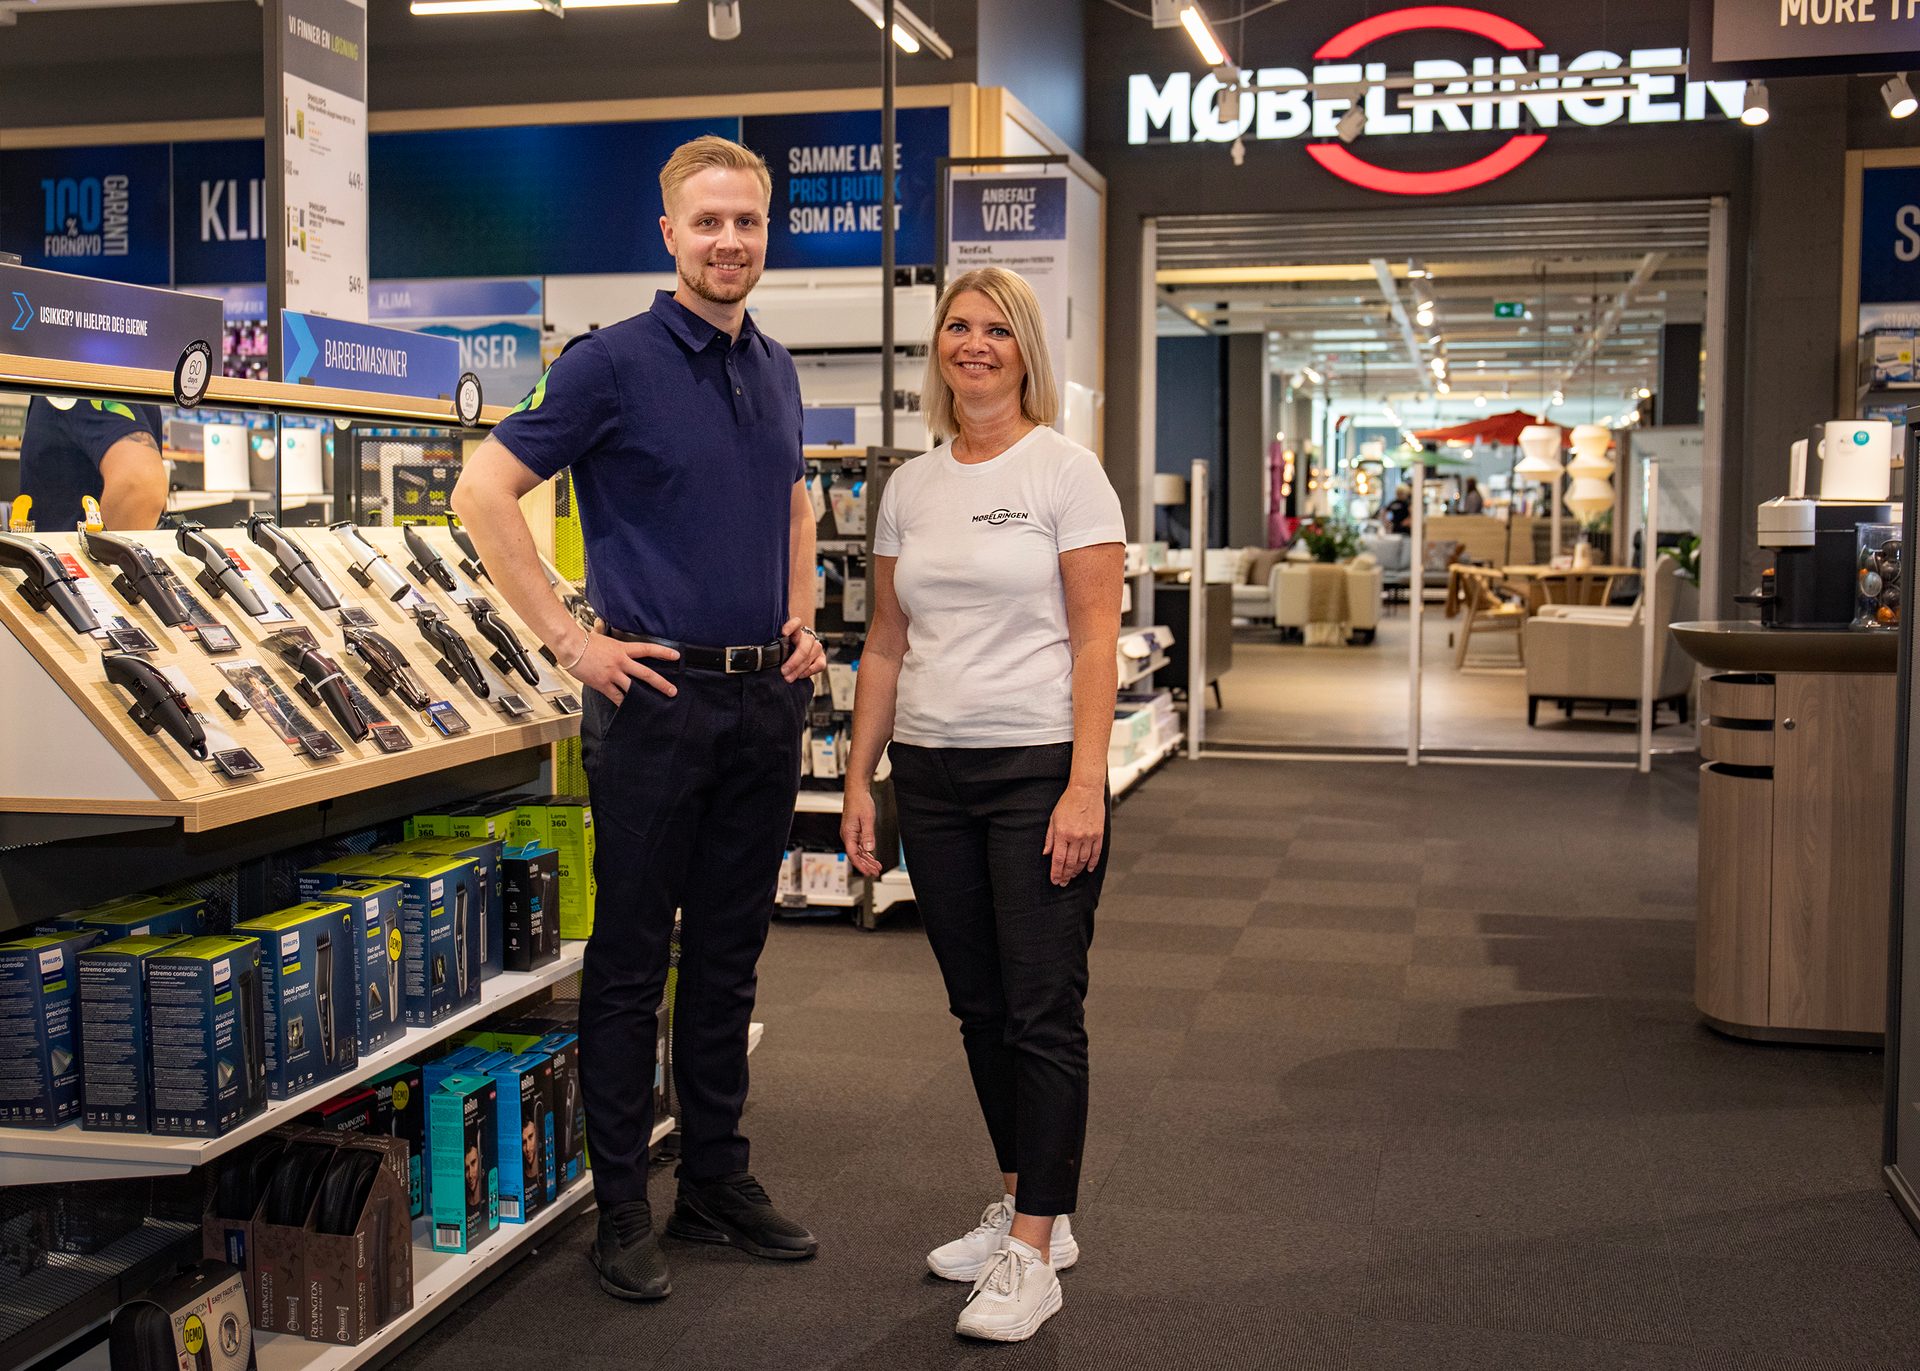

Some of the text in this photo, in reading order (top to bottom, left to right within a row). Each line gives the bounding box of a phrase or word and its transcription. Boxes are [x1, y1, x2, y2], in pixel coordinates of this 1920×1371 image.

[1780, 0, 1876, 26] MORE
[288, 14, 359, 61] VI FINNER EN LØSNING
[1128, 47, 1747, 145] MØBELRINGEN
[788, 145, 856, 174] SAMME
[789, 176, 828, 204] PRIS
[831, 177, 837, 201] I
[981, 187, 1037, 204] ANBEFALT
[41, 177, 100, 233] 100
[103, 174, 129, 257] GARANTI
[201, 178, 267, 242] KLI
[789, 201, 903, 234] SOM PÅ NET
[981, 203, 1037, 232] VARE
[45, 233, 101, 257] FORNØYD
[378, 291, 412, 310] KLIMA
[40, 306, 148, 337] USIKKER? VI HJELPER DEG GJERNE
[185, 343, 202, 356] Money
[324, 339, 408, 379] BARBERMASKINER
[457, 334, 517, 370] NSER
[189, 359, 202, 376] 60
[187, 376, 199, 385] days
[972, 512, 1029, 523] MØBELRINGEN
[418, 829, 434, 837] 360
[516, 819, 531, 827] 360
[551, 819, 567, 827] 360
[454, 830, 470, 838] 360
[390, 936, 401, 953] DEMO
[41, 955, 62, 967] PHILIPS
[215, 967, 229, 977] PHILIPS
[283, 982, 310, 996] Ideal power
[394, 1090, 408, 1100] DEMO
[337, 1113, 367, 1131] REMINGTON
[211, 1281, 242, 1305] EASY FADE PRO
[261, 1271, 270, 1328] REMINGTON
[310, 1281, 319, 1338] REMINGTON
[185, 1326, 203, 1344] DEMO
